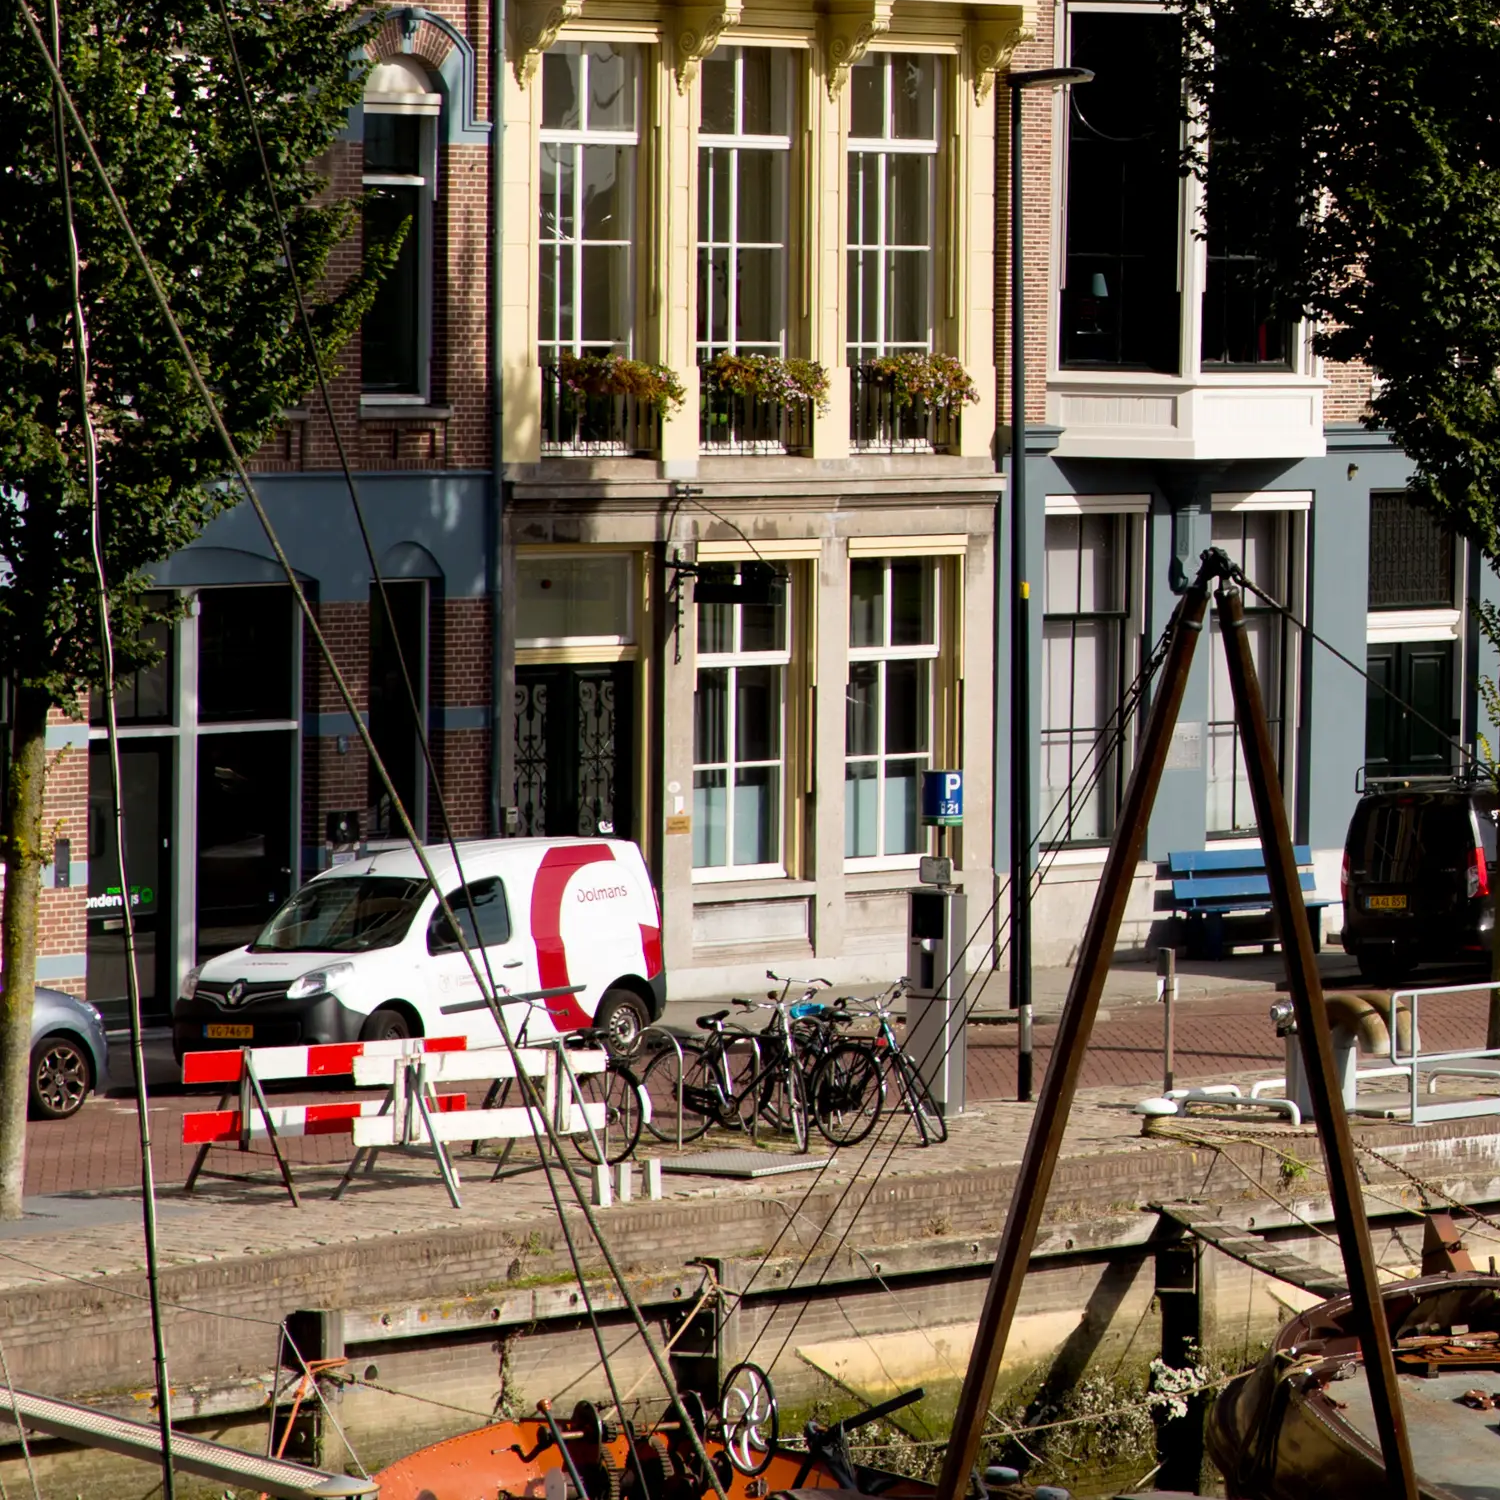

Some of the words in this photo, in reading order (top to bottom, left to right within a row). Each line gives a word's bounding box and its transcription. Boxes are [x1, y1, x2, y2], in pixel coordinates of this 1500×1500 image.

[945, 773, 961, 799] P
[946, 803, 959, 814] 21
[577, 885, 627, 902] Dolmans
